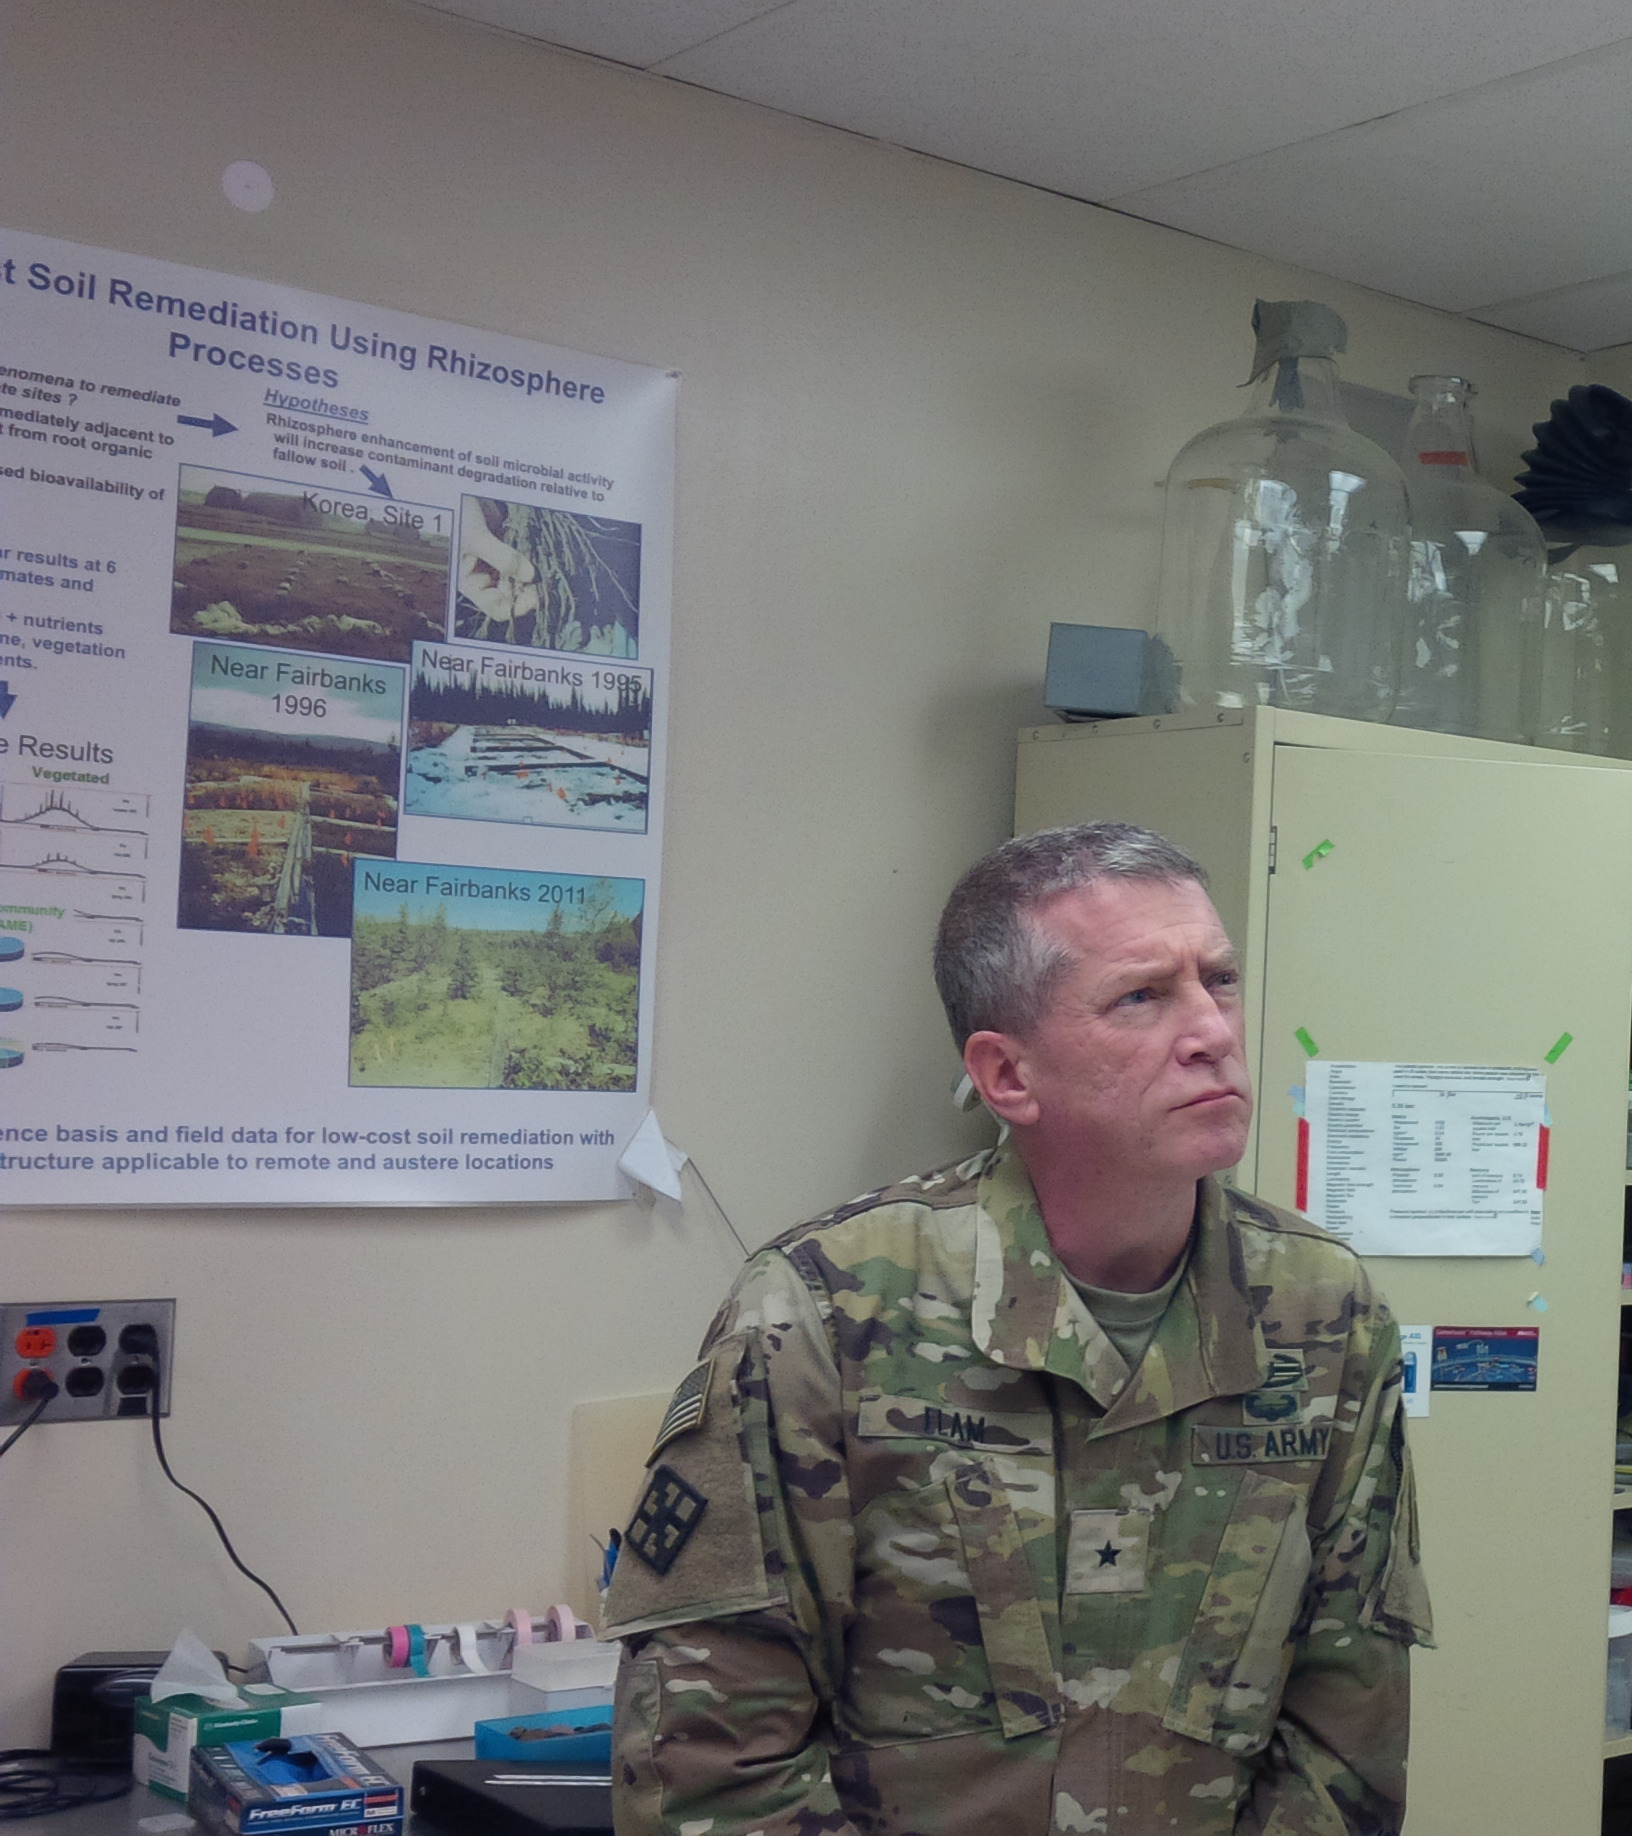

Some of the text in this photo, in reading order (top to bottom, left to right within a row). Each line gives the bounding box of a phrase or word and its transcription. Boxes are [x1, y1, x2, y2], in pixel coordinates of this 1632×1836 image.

[27, 262, 96, 300] Soil
[108, 277, 319, 345] Remediation
[329, 322, 417, 371] Using
[426, 344, 606, 404] Rhizosphere
[167, 331, 340, 388] Processes
[21, 386, 62, 404] sites
[80, 379, 96, 392] to
[100, 382, 182, 408] remediate
[263, 387, 370, 422] Hypotheses
[8, 423, 47, 442] from
[52, 432, 87, 448] root
[90, 440, 154, 462] organic
[84, 420, 155, 445] adjacent
[158, 432, 175, 446] to
[266, 412, 615, 491] Rhizosphere enhancement of soil microbial activity
[272, 447, 347, 472] fallow soil
[274, 431, 606, 502] will increase contaminant degradation relative to
[30, 467, 145, 501] bioavailability
[149, 488, 166, 500] of
[302, 490, 443, 533] Korea, Site 1
[17, 550, 79, 569] results
[85, 559, 101, 573] at
[106, 560, 117, 574] 6
[60, 577, 94, 592] and
[23, 613, 103, 635] nutrients
[32, 636, 126, 659] vegetation
[210, 654, 388, 695] Near Fairbanks
[420, 648, 475, 673] Near
[480, 656, 584, 688] Fairbanks
[271, 693, 328, 719] 1996
[18, 734, 114, 764] Results
[31, 765, 110, 785] Vegetated
[362, 871, 587, 906] Near Fairbanks 2011
[56, 1124, 118, 1143] basis
[126, 1125, 169, 1143] and
[175, 1125, 224, 1144] field
[231, 1126, 278, 1144] data
[285, 1126, 316, 1144] for
[322, 1127, 412, 1145] low-cost
[416, 1127, 454, 1145] soil
[460, 1128, 574, 1146] remediation
[580, 1129, 615, 1146] with
[101, 1153, 220, 1174] applicable
[226, 1153, 249, 1171] to
[255, 1155, 330, 1171] remote
[337, 1153, 376, 1171] and
[382, 1155, 459, 1171] austere
[465, 1154, 555, 1171] locations
[1215, 1427, 1330, 1460] U.S. ARMY
